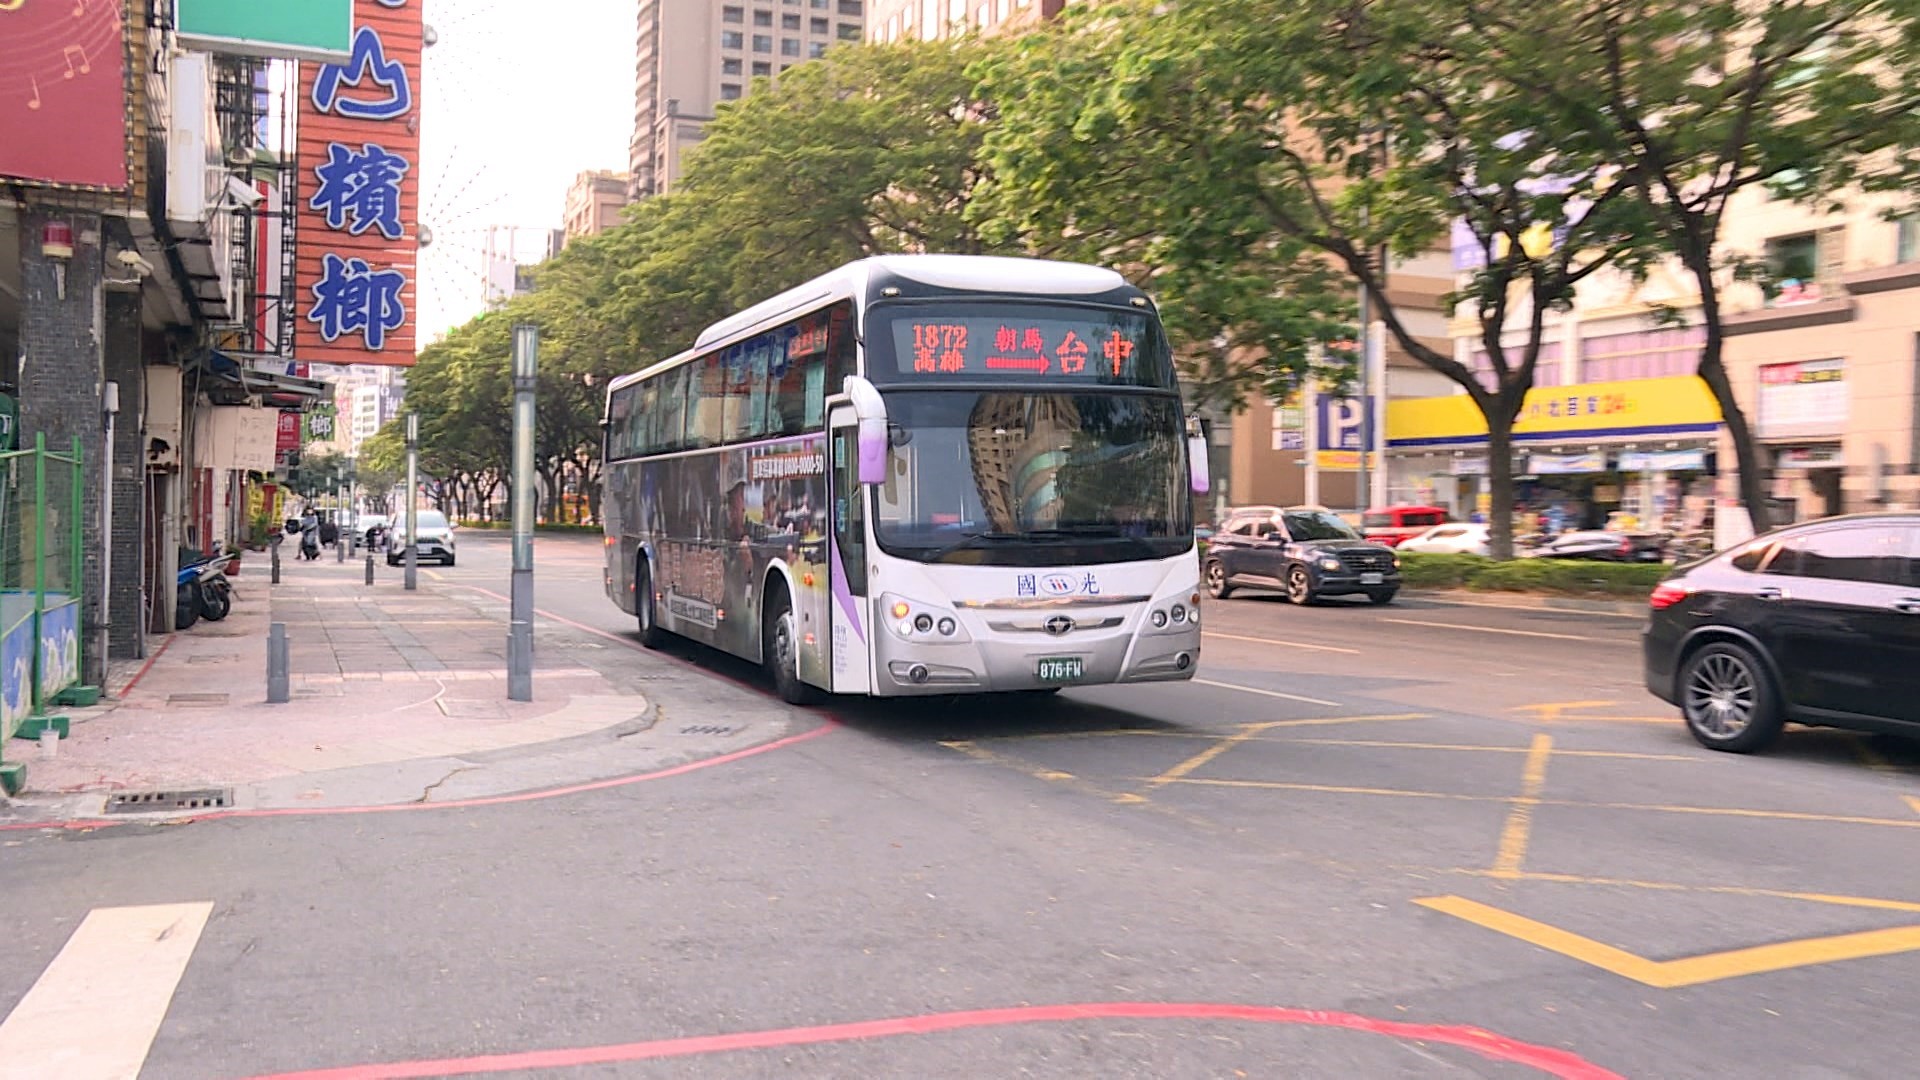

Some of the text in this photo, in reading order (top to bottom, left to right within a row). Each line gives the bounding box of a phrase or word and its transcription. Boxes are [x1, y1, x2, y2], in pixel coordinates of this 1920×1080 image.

[308, 0, 412, 352] 山檳榔
[912, 324, 968, 348] 1872
[994, 325, 1044, 354] 朝馬
[1056, 329, 1135, 377] 台中
[1327, 398, 1365, 449] P
[1017, 571, 1100, 597] 國 光
[1040, 660, 1081, 679] 876-FW
